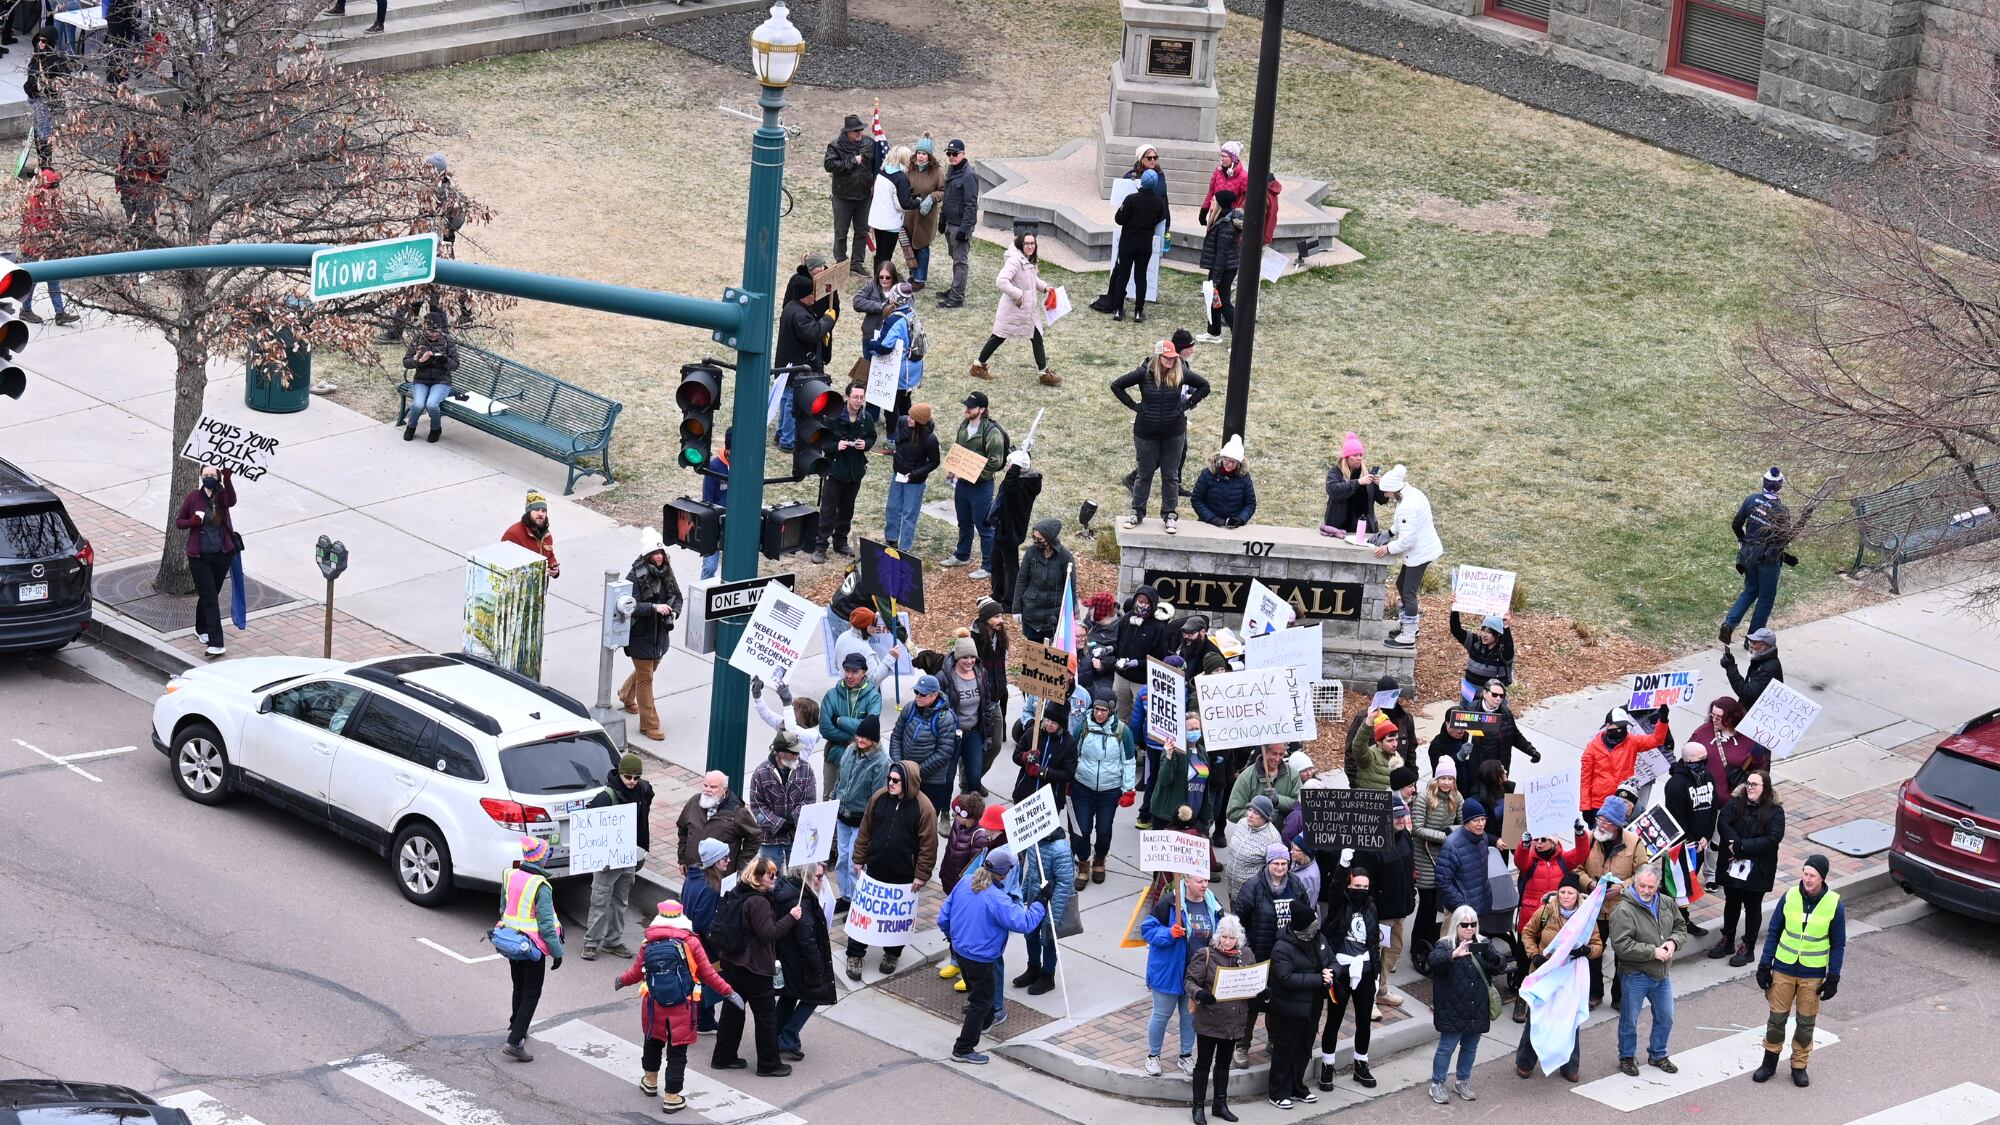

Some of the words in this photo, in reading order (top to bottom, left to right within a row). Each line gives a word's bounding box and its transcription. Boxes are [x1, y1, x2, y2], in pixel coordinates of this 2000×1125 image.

[318, 259, 377, 289] Kiowa
[208, 435, 256, 464] 401K
[244, 430, 279, 455] YOUR
[183, 443, 267, 482] LOOKING?
[1242, 540, 1275, 556] 107
[714, 592, 740, 608] ONE
[748, 588, 764, 603] WA
[1151, 576, 1244, 608] CITY
[1269, 584, 1354, 614] ALL
[746, 646, 756, 656] TO
[757, 653, 774, 666] GOD
[754, 632, 764, 641] TO
[767, 638, 800, 660] TYRANTS
[754, 642, 794, 668] OBEDIENCE
[1044, 648, 1069, 667] bad
[1152, 668, 1176, 686] HANDS
[1634, 674, 1671, 691] DON'T
[1672, 672, 1689, 686] TAX
[959, 688, 980, 700] ESIS
[1152, 678, 1176, 700] OFF!
[1201, 681, 1276, 700] RACIAL
[1630, 692, 1653, 709] ME
[1653, 687, 1681, 707] BRO!
[1152, 694, 1177, 723] FREE
[1284, 668, 1304, 732] JUSTICE
[1769, 684, 1816, 716] HISTORY
[1204, 702, 1266, 720] GENDER
[1759, 695, 1783, 713] HAS
[1784, 710, 1807, 728] ITS
[1151, 712, 1178, 736] SPEECH
[1208, 722, 1290, 742] ECONOMIC
[1751, 708, 1780, 730] EYES
[1779, 725, 1800, 742] ON
[1753, 726, 1780, 749] YOU
[1022, 799, 1036, 808] POWER
[1305, 791, 1315, 799] IF
[1332, 790, 1350, 799] SIGN
[1354, 791, 1390, 800] OFFENDS
[1014, 814, 1026, 826] THE
[1027, 802, 1046, 821] PEOPLE
[1340, 801, 1391, 811] SURPRISED...
[596, 811, 625, 826] Tater
[1018, 822, 1035, 834] GREATER
[1035, 816, 1045, 825] THAN
[1313, 811, 1318, 821] I
[1353, 812, 1381, 824] THINK
[1019, 831, 1033, 843] PEOPLE
[1038, 820, 1051, 831] POWER
[1305, 822, 1324, 832] YOU
[1326, 823, 1348, 833] GUYS
[1351, 824, 1378, 834] KNEW
[579, 833, 608, 850] Donald
[616, 829, 624, 845] &
[1175, 836, 1207, 849] ANYWHERE
[1315, 833, 1336, 844] HOW
[1340, 833, 1352, 845] TO
[1357, 835, 1385, 848] READ
[608, 849, 636, 866] Musk
[1170, 845, 1192, 855] THREAT
[1144, 854, 1170, 862] JUSTICE
[1174, 855, 1209, 869] EVERYWHERE
[861, 879, 903, 900] DEFEND
[853, 888, 915, 916] DEMOCRACY
[850, 908, 872, 930] DUMP
[877, 917, 916, 933] TRUMP!
